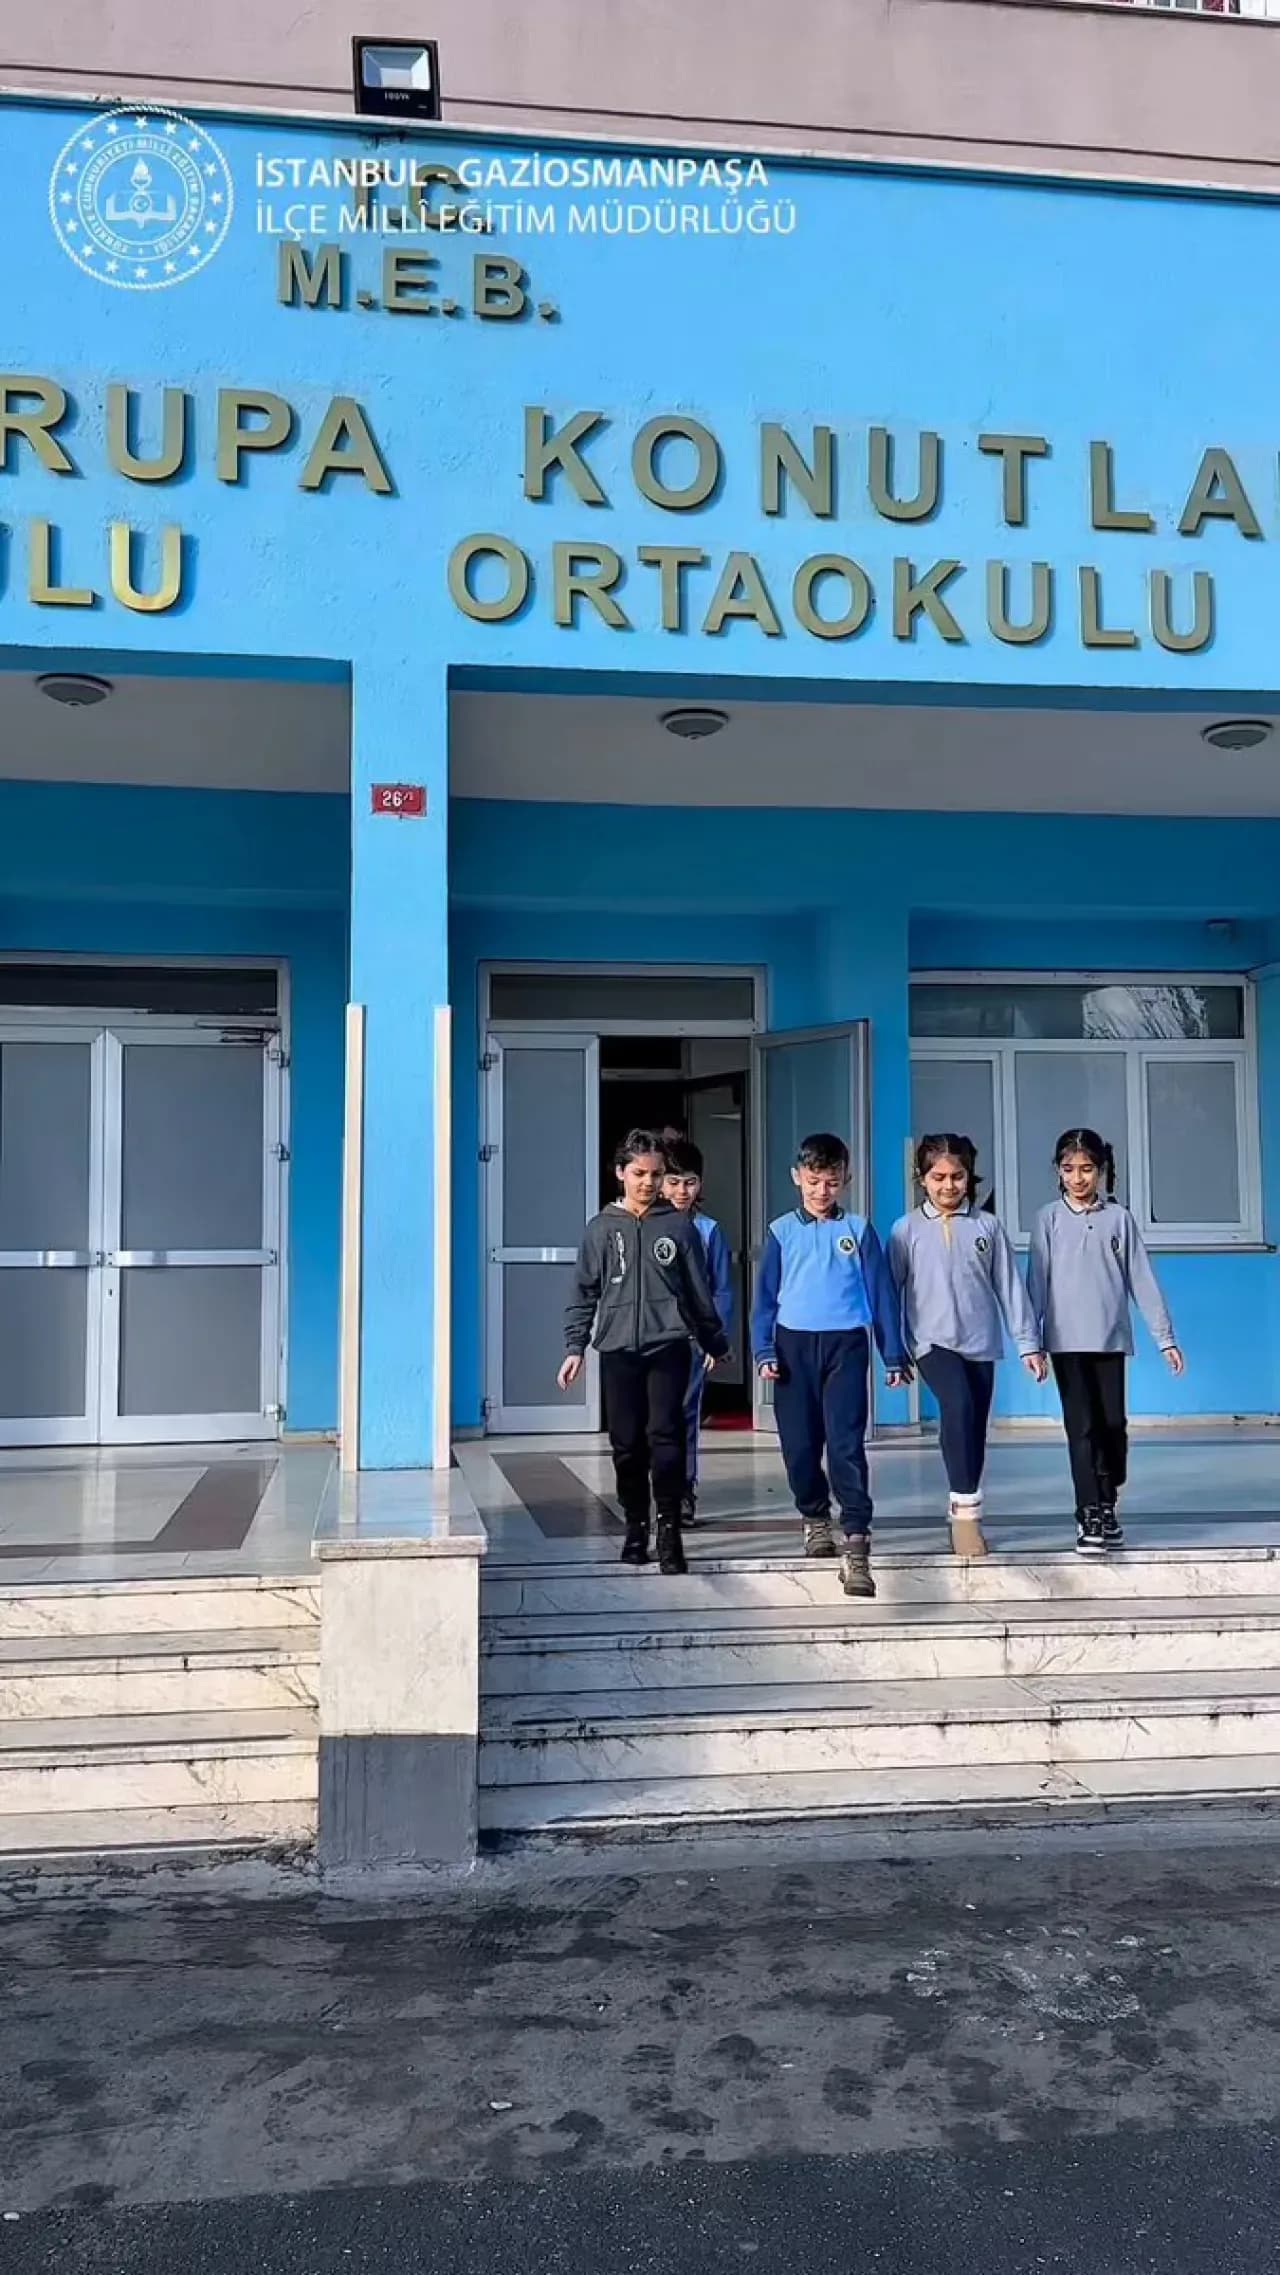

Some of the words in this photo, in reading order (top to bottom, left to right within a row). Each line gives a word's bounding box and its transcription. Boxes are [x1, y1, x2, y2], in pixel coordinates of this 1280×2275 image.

[278, 240, 559, 321] M.E.B.
[0, 374, 391, 492] RUPA
[523, 406, 1280, 538] KONUTLA
[447, 533, 1213, 653] ORTAOKULU
